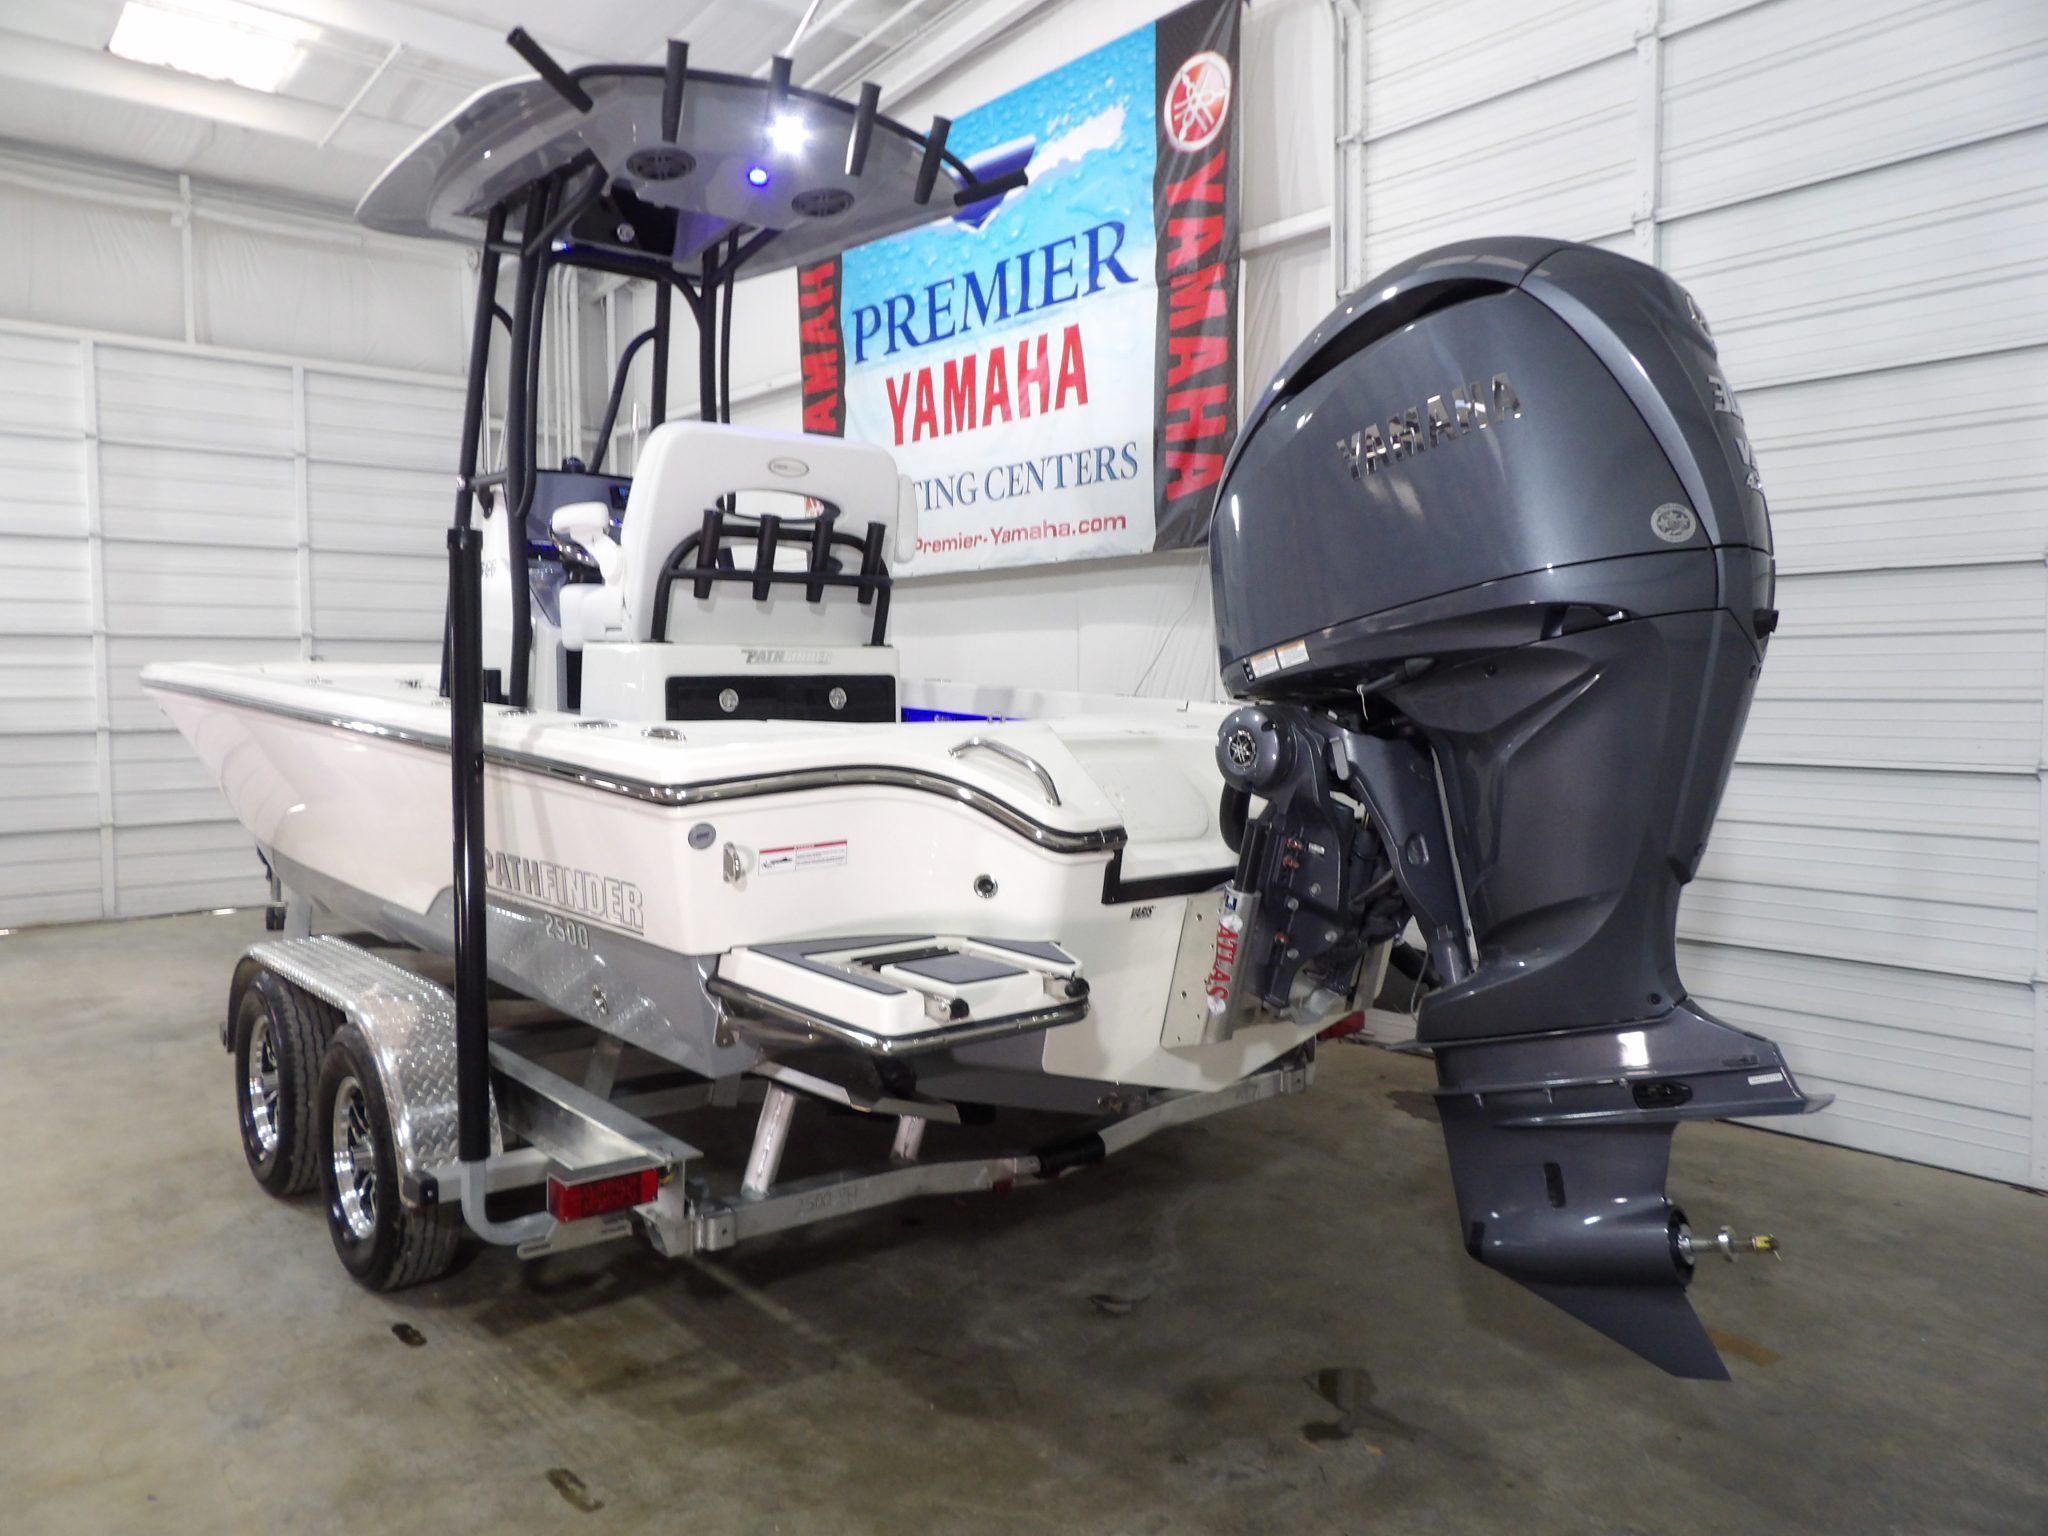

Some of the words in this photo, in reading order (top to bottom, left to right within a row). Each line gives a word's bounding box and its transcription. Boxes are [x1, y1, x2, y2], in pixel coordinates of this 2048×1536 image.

[852, 220, 1138, 364] PREMIER
[1165, 149, 1229, 501] YAMAHA
[801, 261, 839, 433] AMAH
[886, 323, 1088, 446] YAMAHA
[984, 441, 1138, 501] CENTERS
[1336, 372, 1522, 480] YAMAHA
[485, 848, 645, 929] PATHFINDER
[544, 913, 590, 950] 2500
[1206, 922, 1239, 1000] ATLAS
